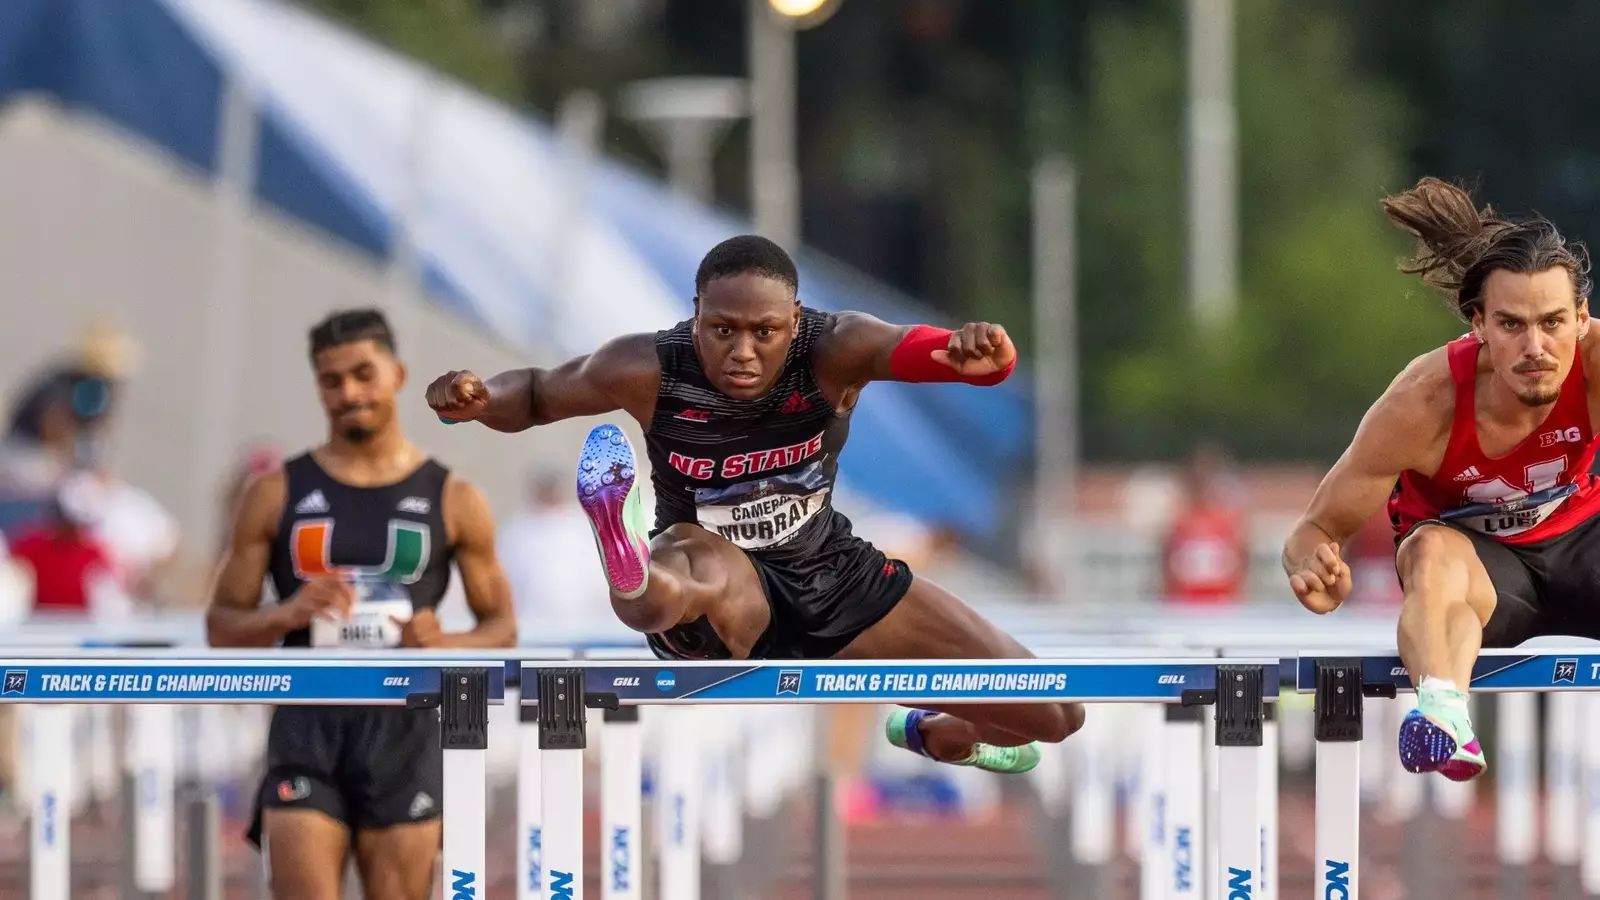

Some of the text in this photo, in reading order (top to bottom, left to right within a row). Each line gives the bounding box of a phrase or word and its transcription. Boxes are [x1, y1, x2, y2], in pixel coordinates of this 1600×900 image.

[678, 408, 712, 421] ACC
[669, 430, 825, 480] NC STATE
[731, 495, 792, 521] CAMERO
[717, 497, 811, 541] MURRAY
[41, 674, 292, 692] TRACK & FIELD CHAMPIONSHIPS
[383, 676, 410, 686] GILL
[612, 676, 640, 686] GILL
[815, 673, 1067, 691] TRACK & FIELD CHAMPIONSHIPS
[1158, 674, 1186, 684] GILL
